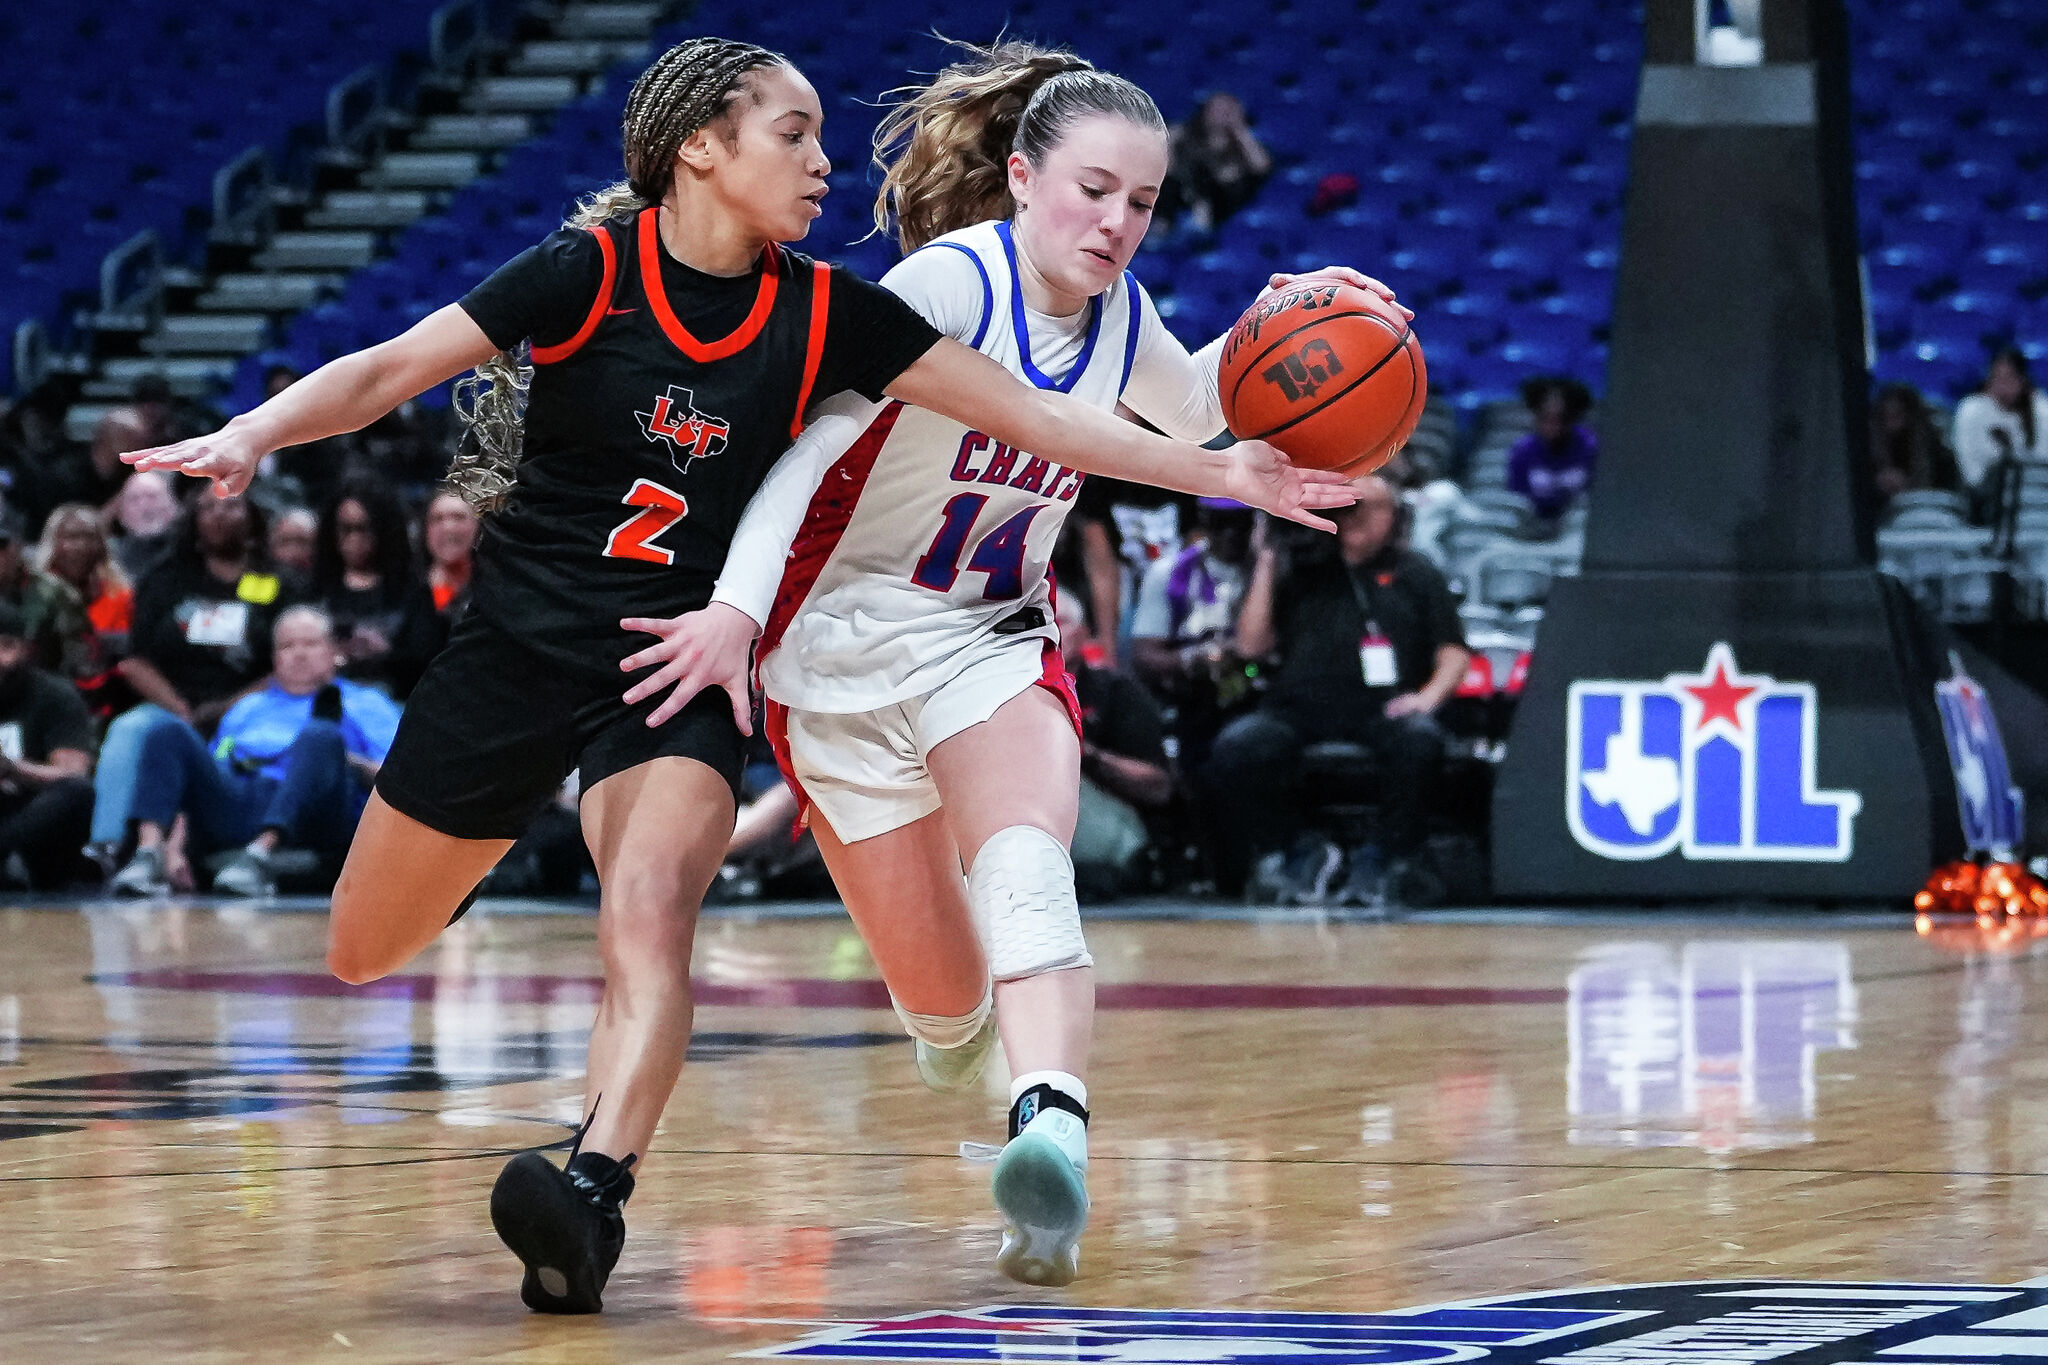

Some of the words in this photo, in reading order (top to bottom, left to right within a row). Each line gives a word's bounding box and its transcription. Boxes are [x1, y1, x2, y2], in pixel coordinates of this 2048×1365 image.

[1261, 338, 1345, 403] UIL
[602, 478, 689, 566] 2
[910, 491, 1051, 600] 14
[1566, 676, 1863, 861] UIL
